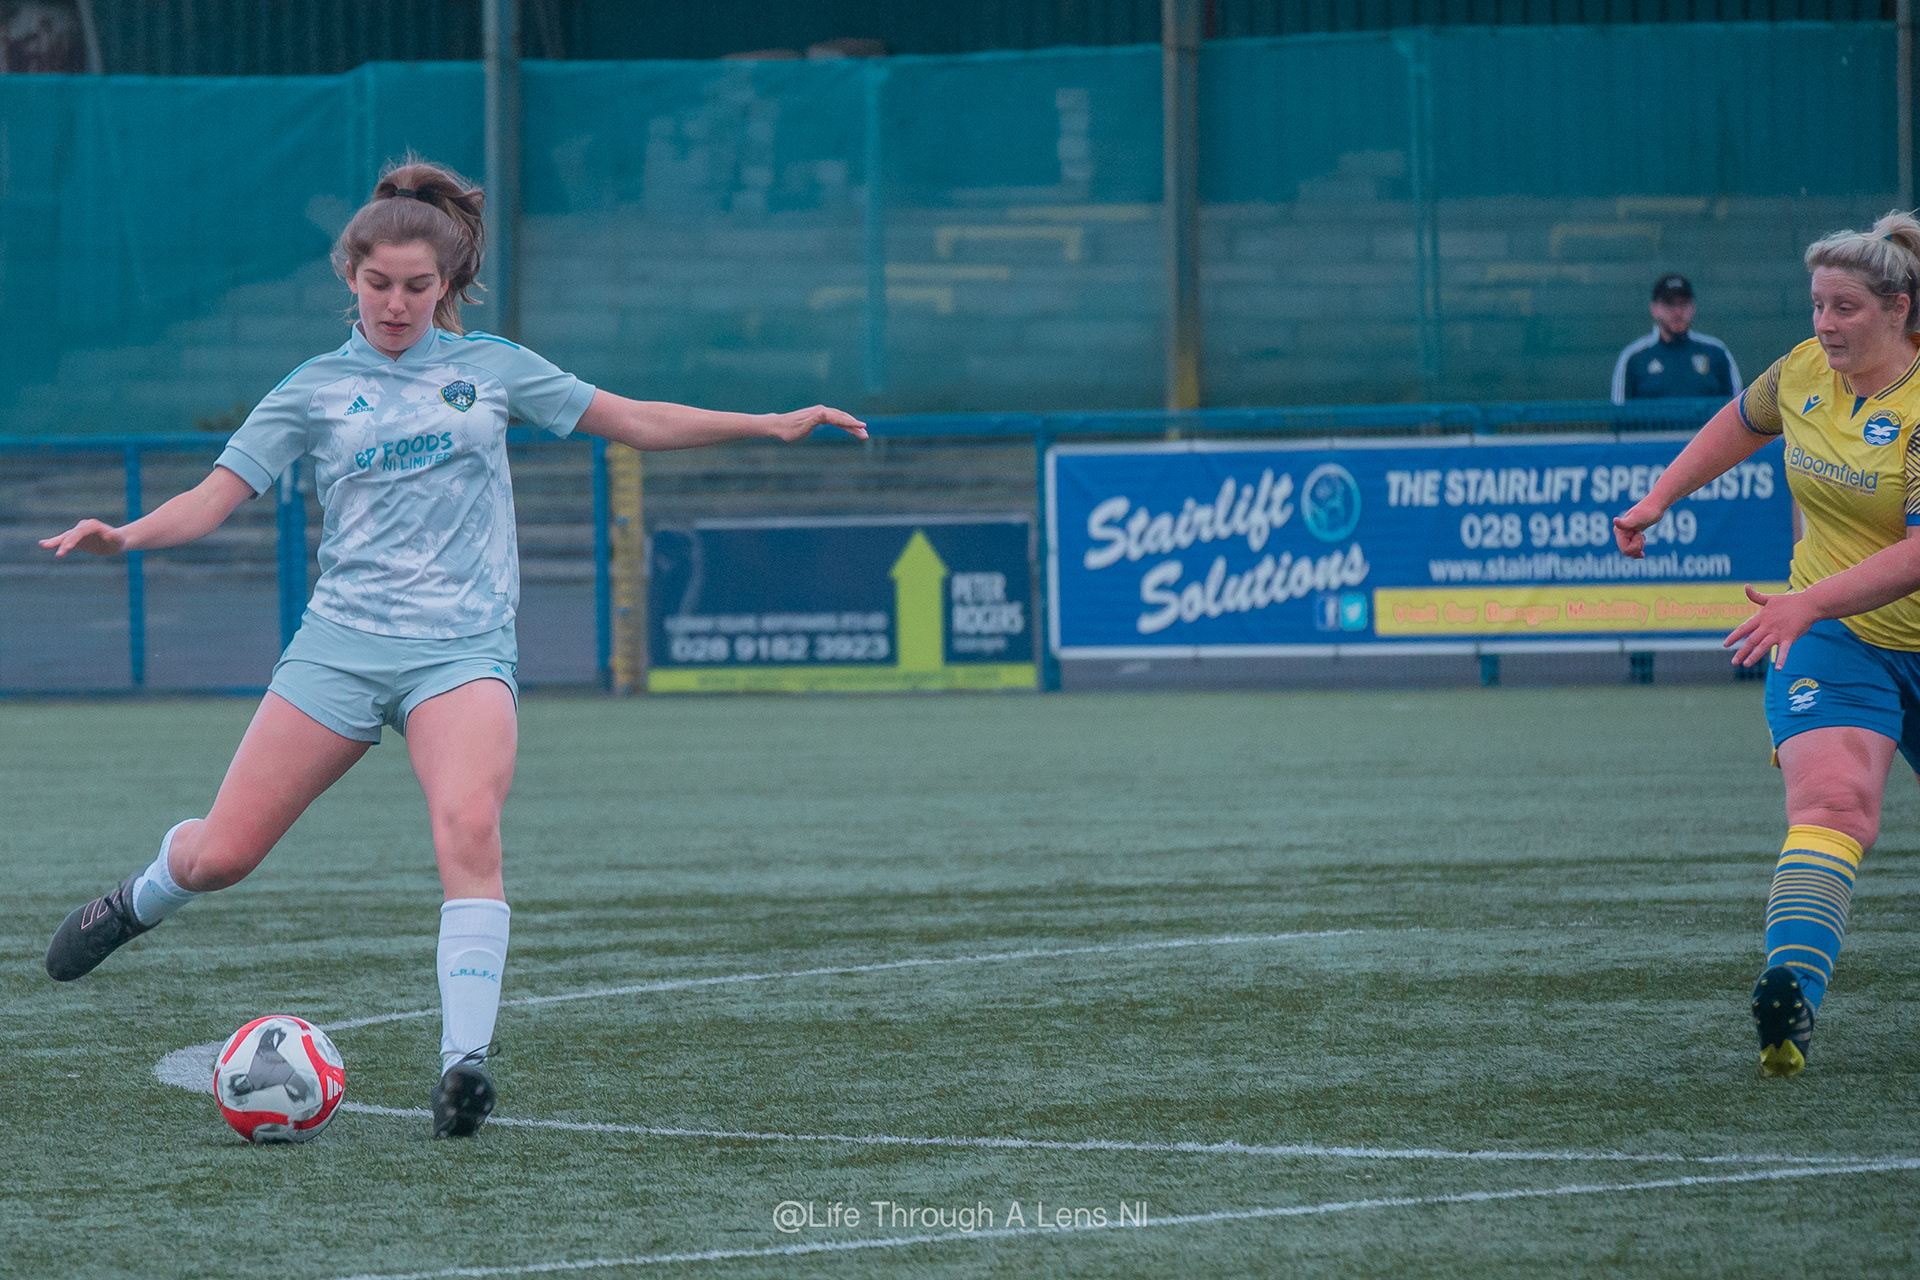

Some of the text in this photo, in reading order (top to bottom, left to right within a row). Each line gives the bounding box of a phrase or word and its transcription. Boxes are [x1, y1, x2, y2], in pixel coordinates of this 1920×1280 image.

[355, 432, 453, 470] BP FOODS
[383, 452, 453, 472] NI LIMITED
[1790, 447, 1879, 489] Bloomfield
[1386, 462, 1774, 507] THE STAIRLIFT SPECLISTS
[1083, 468, 1294, 570] Stairlift
[1460, 512, 1523, 549] 028
[1528, 511, 1610, 548] 9188
[1136, 541, 1370, 634] Solutions
[1567, 600, 1648, 625] Mobility
